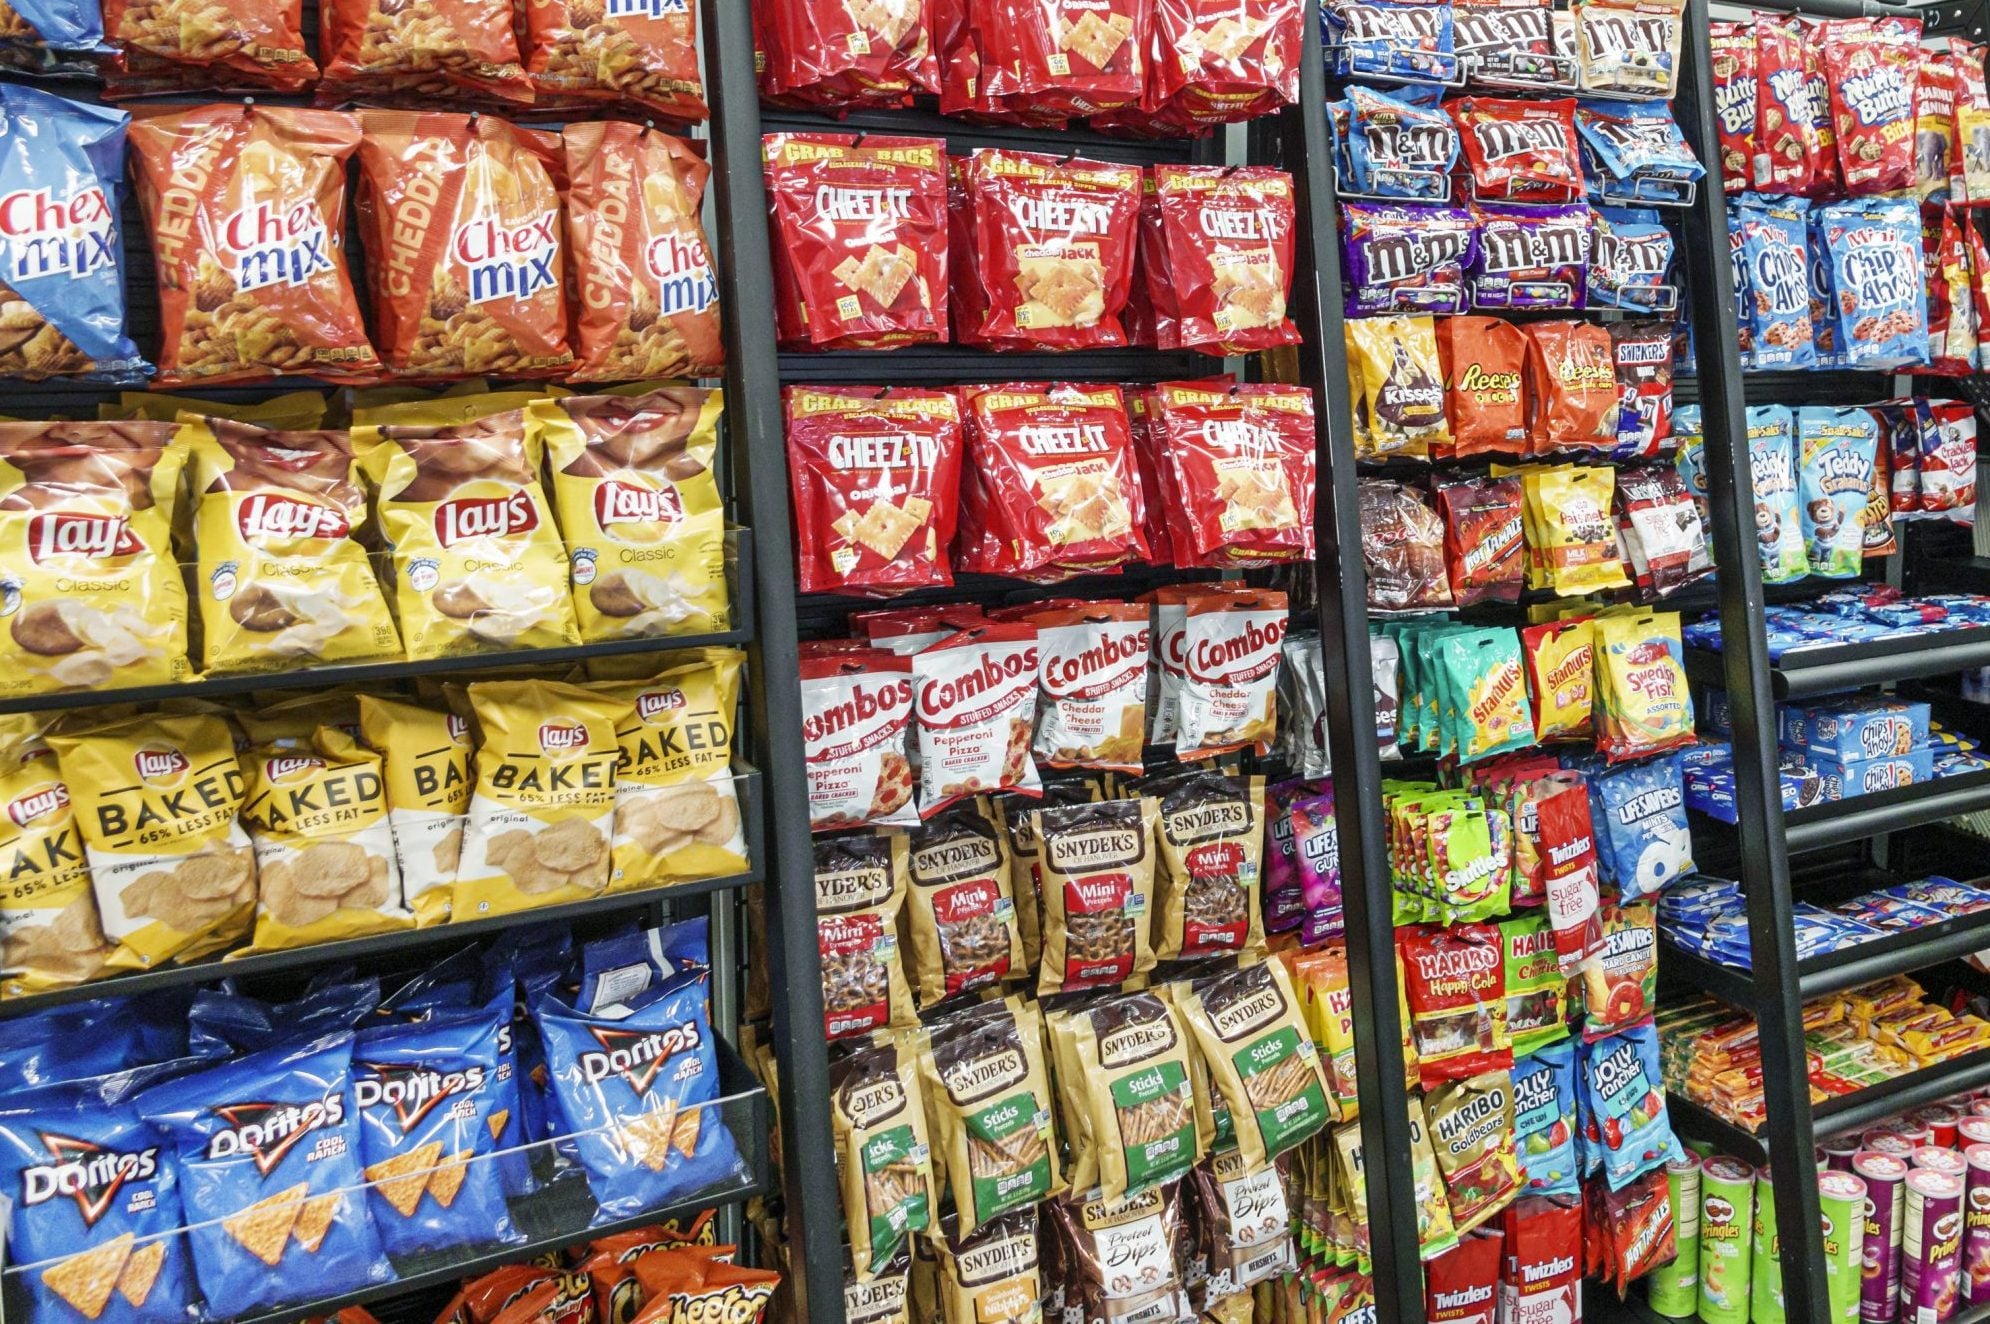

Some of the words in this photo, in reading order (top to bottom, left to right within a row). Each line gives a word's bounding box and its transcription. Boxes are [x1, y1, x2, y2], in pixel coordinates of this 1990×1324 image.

[784, 143, 843, 160] GRAB
[878, 149, 933, 164] BAGS
[990, 156, 1044, 177] GRAB
[1171, 173, 1218, 188] GRAB
[0, 190, 112, 235] Chex
[389, 139, 448, 296] CHEDDAR
[226, 201, 319, 250] Chex
[585, 154, 634, 308] CHEDDAR
[457, 213, 556, 263] Chex
[18, 229, 114, 274] mix
[242, 232, 333, 288] mix
[473, 249, 556, 299] mix
[1759, 250, 1802, 288] Chips
[1620, 343, 1666, 361] SNICKERS
[1461, 364, 1521, 392] Reese's
[1559, 361, 1614, 382] Reese's
[803, 395, 861, 410] GRAB
[895, 400, 952, 415] BAGS
[985, 395, 1040, 409] GRAB
[1173, 390, 1222, 405] GRAB
[1252, 396, 1302, 410] BAGS
[1941, 442, 1976, 460] Cracker
[1819, 449, 1869, 479] Teddy
[1947, 457, 1970, 473] Jack
[1822, 475, 1870, 496] Grahams
[602, 479, 677, 525] Lay's
[244, 494, 346, 538] Lay's
[445, 491, 527, 549] Lay's
[39, 514, 134, 558] Lay's
[464, 558, 523, 572] Classic
[620, 545, 675, 563] Classic
[1568, 548, 1586, 559] MILK
[56, 577, 129, 592] Classic
[1198, 618, 1288, 673] Combos
[1046, 628, 1150, 688] Combos
[1229, 669, 1255, 683] STUFFED
[1256, 656, 1278, 678] SNACKS
[922, 647, 1038, 716] Combos
[1112, 671, 1134, 691] SNACKS
[1626, 664, 1675, 692] Swedish
[1209, 689, 1251, 699] Cheddar
[1645, 682, 1675, 699] Fish
[639, 690, 682, 716] Lay's
[804, 679, 912, 742] ombos
[960, 709, 992, 725] STUFFED
[992, 691, 1020, 713] SNACKS
[1062, 703, 1105, 714] Cheddar
[1213, 700, 1248, 709] Cheese
[1647, 702, 1681, 715] ASSORTED
[1065, 714, 1101, 725] Cheese
[541, 723, 586, 751] Lay's
[863, 725, 894, 746] SNACKS
[934, 730, 993, 750] Pepperoni
[1862, 722, 1888, 744] Chips
[617, 721, 729, 772] BAKED
[949, 744, 981, 756] Pizza
[137, 750, 182, 779] Lay's
[637, 763, 660, 776] 65%
[664, 756, 690, 772] LESS
[695, 752, 713, 766] FAT
[816, 777, 848, 790] Pizza
[1864, 765, 1889, 790] Chips
[11, 782, 69, 821] Lay's
[97, 770, 244, 837] BAKED
[520, 793, 544, 803] 65%
[139, 826, 172, 844] 65%
[177, 815, 214, 835] LESS
[296, 812, 330, 831] LESS
[336, 806, 359, 822] FAT
[490, 813, 529, 826] original
[1174, 805, 1243, 832] SNYDER'S
[918, 840, 992, 871] SNYDER'S
[1056, 834, 1134, 859] SNYDER'S
[1085, 852, 1118, 863] HANOVER
[1199, 849, 1230, 865] Mini
[1549, 836, 1591, 865] Twizzlers
[1445, 852, 1508, 892] Skittles
[1553, 862, 1576, 876] TWISTS
[14, 880, 46, 899] 65%
[1081, 881, 1115, 898] Mini
[1086, 896, 1112, 905] Pretzels
[1552, 879, 1583, 904] sugar
[1560, 898, 1583, 916] free
[1417, 946, 1499, 980] HARIBO
[1603, 957, 1625, 970] HARD
[1626, 950, 1652, 965] CANDY
[1430, 978, 1469, 996] Happy
[1471, 972, 1497, 990] Cola
[1219, 993, 1276, 1030] SNYDER'S
[585, 1023, 700, 1082] Doritos
[1105, 1028, 1166, 1056] SNYDER'S
[1251, 1038, 1283, 1061] Sticks
[1261, 1051, 1281, 1065] Pretzels
[1594, 1043, 1634, 1090] JOLLY
[674, 1065, 702, 1081] RANCH
[954, 1054, 1018, 1093] SNYDER'S
[1129, 1072, 1163, 1093] Sticks
[1513, 1069, 1553, 1101] OLLY
[1601, 1060, 1642, 1100] rancher
[355, 1065, 485, 1108] Doritos
[1139, 1086, 1159, 1098] Pretzels
[1514, 1087, 1557, 1115] ancher
[983, 1105, 1019, 1128] Sticks
[994, 1119, 1015, 1132] Pretzels
[1437, 1089, 1504, 1141] HARIBO
[209, 1094, 345, 1161] Doritos
[1450, 1115, 1504, 1154] Goldbears
[308, 1146, 346, 1162] RANCH
[315, 1136, 346, 1151] COOL
[24, 1147, 157, 1207] Doritos
[1234, 1178, 1271, 1198] Pretzel
[128, 1199, 156, 1213] RANCH
[1114, 1210, 1146, 1223] HANOVER
[1234, 1194, 1279, 1219] Dips
[1109, 1225, 1153, 1246] Pretzel
[963, 1239, 1032, 1273] SNYDER'S
[1107, 1240, 1160, 1268] Dips
[1248, 1251, 1278, 1272] HERSHEY'S
[1624, 1244, 1645, 1269] HOT
[1521, 1256, 1574, 1282] Twizzlers
[1433, 1285, 1492, 1309] Twizzlers
[1524, 1281, 1551, 1293] TWISTS
[1126, 1303, 1161, 1323] HERSHEY'S
[1435, 1308, 1464, 1319] TWISTS
[1519, 1298, 1557, 1317] sugar
